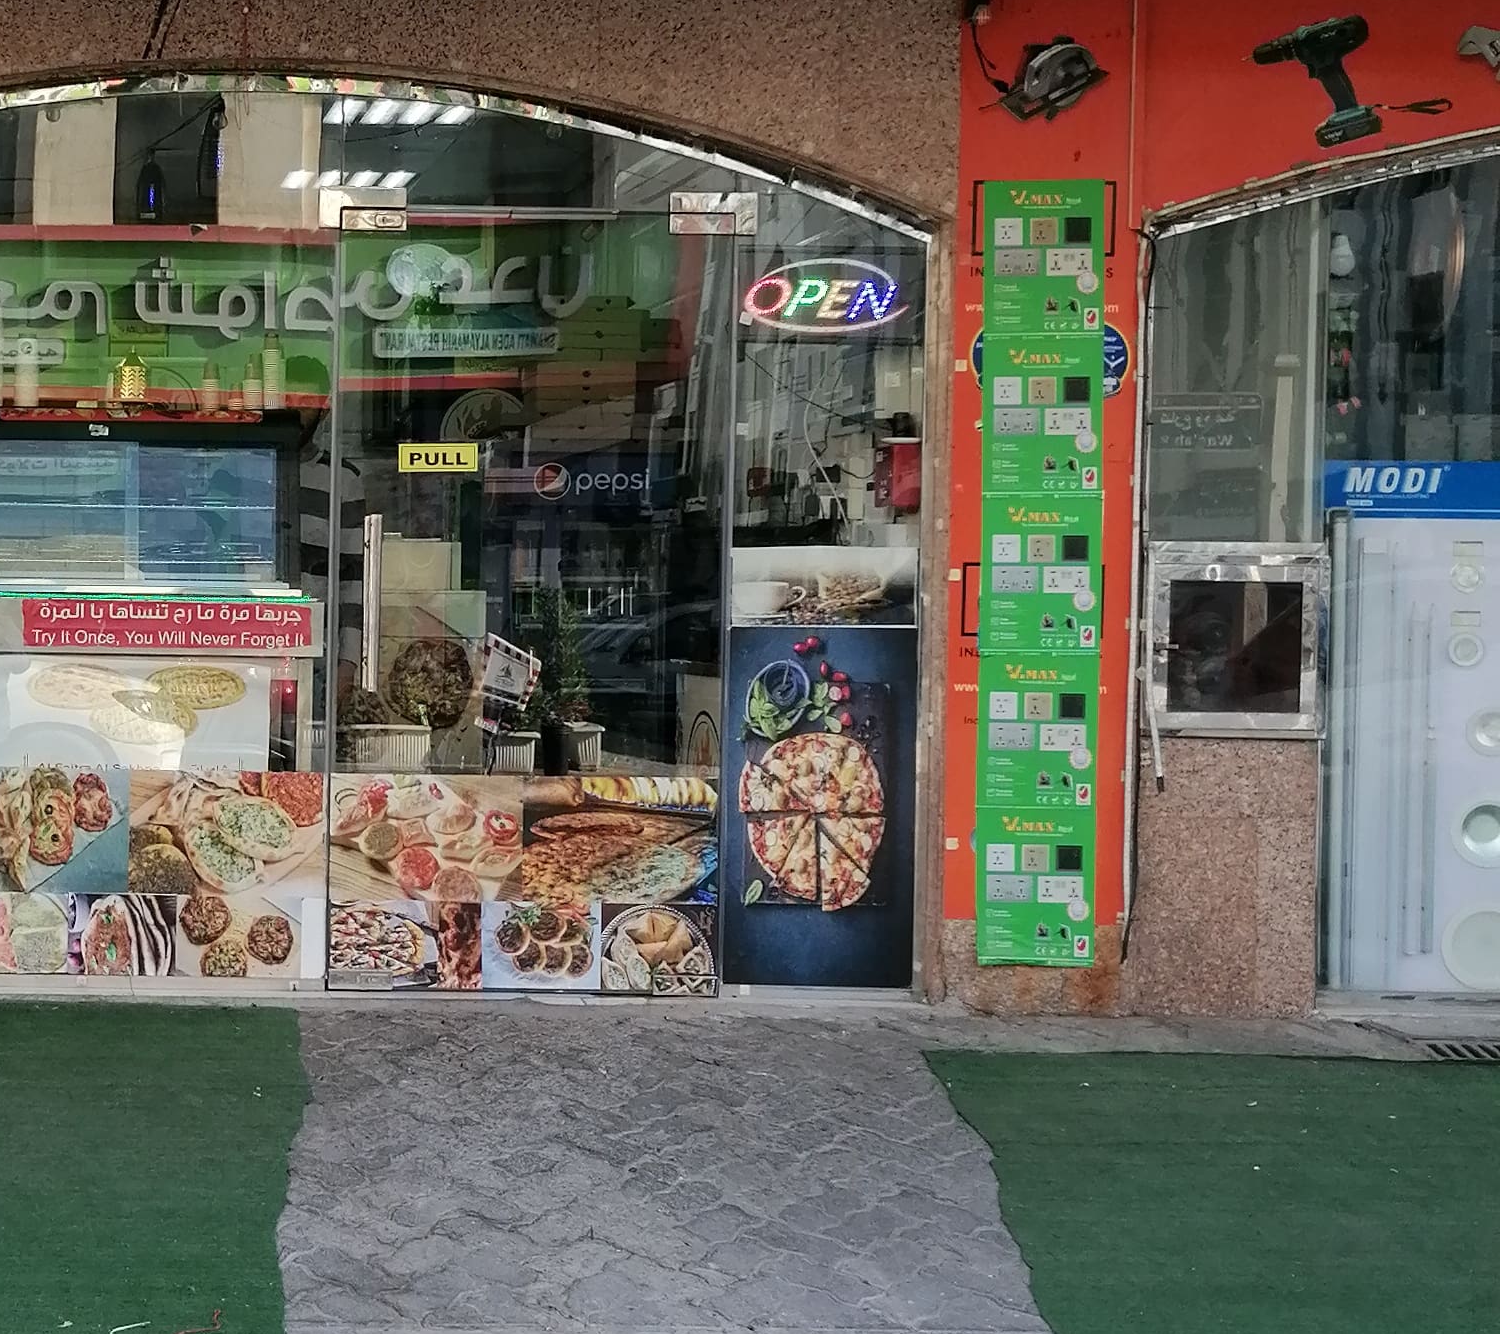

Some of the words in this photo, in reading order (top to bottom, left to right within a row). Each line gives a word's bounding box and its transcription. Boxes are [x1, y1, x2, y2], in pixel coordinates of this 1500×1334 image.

[743, 275, 898, 321] OPEN
[408, 452, 469, 466] PULL
[575, 468, 650, 496] pepsi
[1343, 467, 1442, 494] MODI
[39, 602, 85, 623] المرة
[90, 602, 104, 623] با
[109, 603, 169, 619] تنساها
[173, 607, 192, 624] رح
[197, 604, 215, 620] ما
[219, 604, 250, 624] مرة
[255, 605, 303, 626] جربها
[32, 629, 56, 647] Try
[61, 629, 71, 644] It
[74, 629, 120, 646] Once,
[124, 630, 154, 644] You
[158, 630, 186, 645] Will
[190, 631, 236, 646] Never
[241, 632, 290, 649] Forget
[295, 633, 304, 647] It
